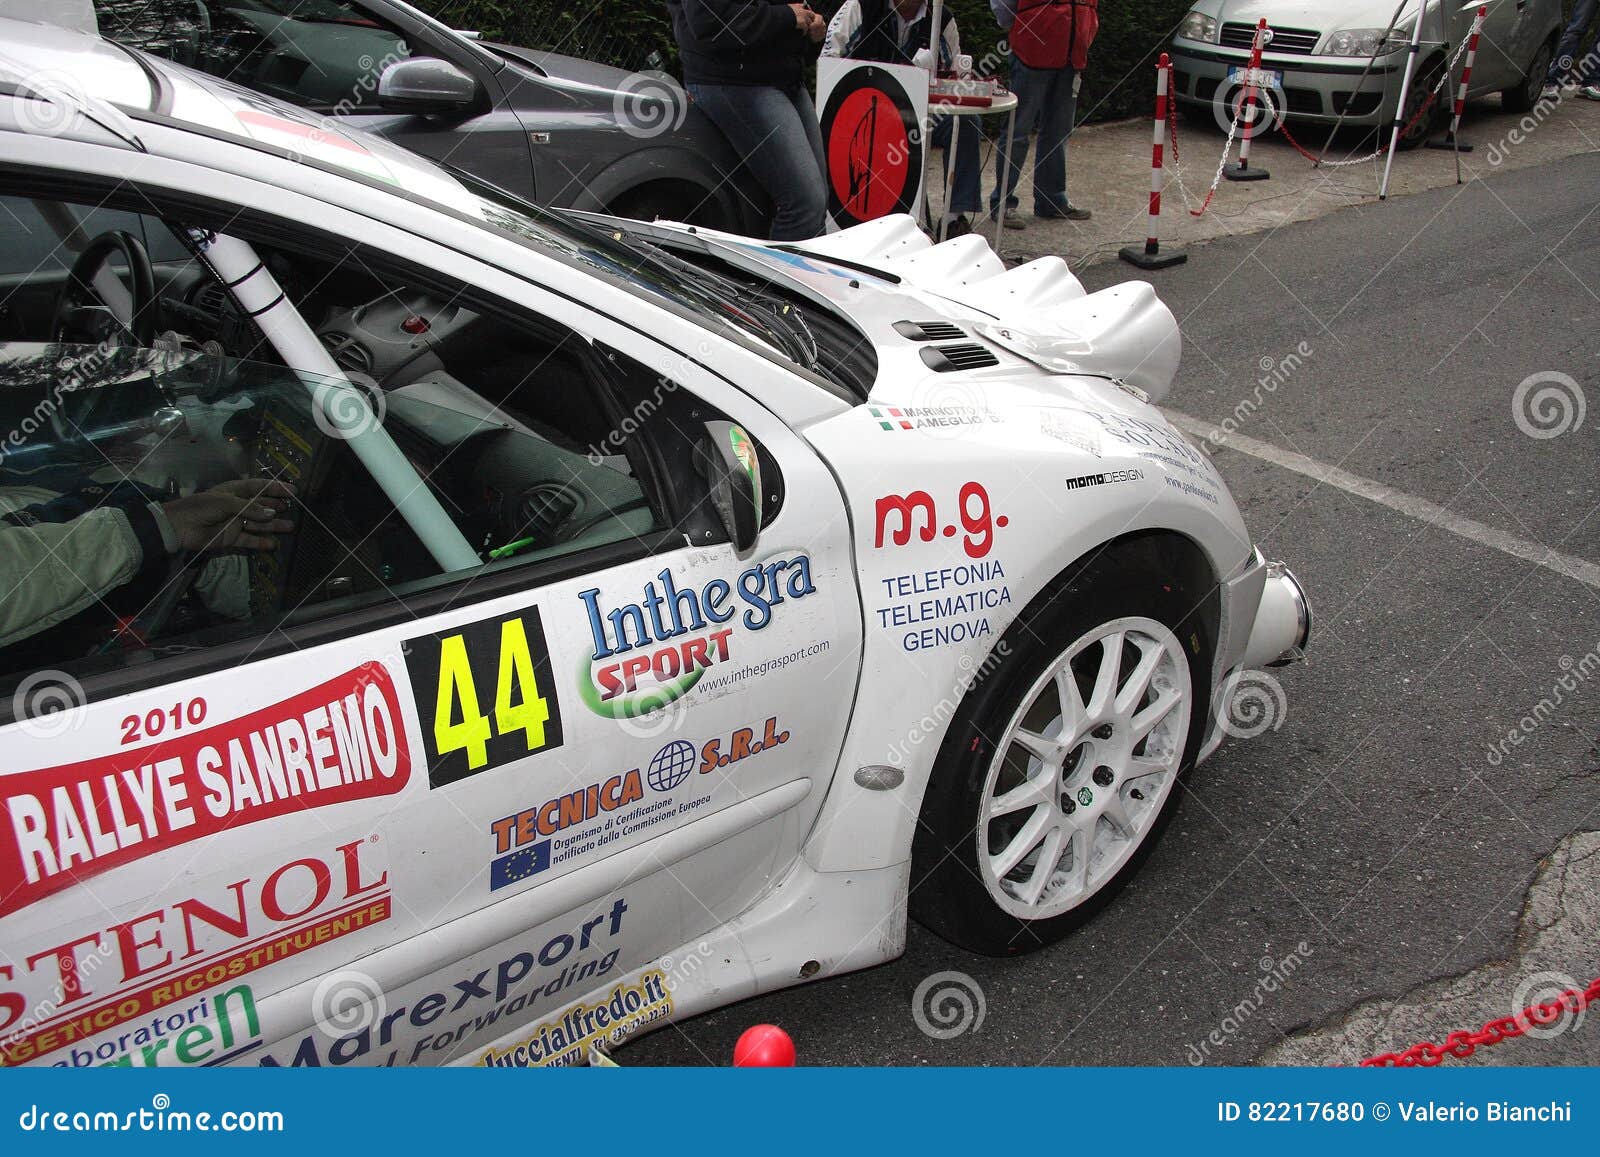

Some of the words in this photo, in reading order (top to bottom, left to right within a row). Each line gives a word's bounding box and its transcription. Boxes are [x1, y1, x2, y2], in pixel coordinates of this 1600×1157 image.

[875, 481, 1009, 558] m.g.
[877, 586, 1011, 628] TELEMATICA
[882, 560, 1004, 598] TELEFONIA
[597, 628, 732, 701] SPORT
[698, 640, 830, 693] www.inthegrasport.com
[903, 618, 990, 652] GENOVA
[121, 697, 207, 745] 2010
[434, 618, 549, 771] 44
[7, 757, 195, 884] RALLYE
[197, 682, 397, 818] SANREMO
[491, 768, 644, 854] TECNICA
[700, 716, 790, 774] S.R.L.
[553, 841, 595, 865] notificato
[597, 831, 620, 847] dalla
[622, 808, 677, 836] Commissione
[678, 795, 711, 814] Europea
[554, 826, 602, 850] Organismo
[605, 818, 614, 830] di
[616, 797, 673, 826] Certificazione
[151, 902, 386, 1006] RICOSTITUENTE
[409, 947, 621, 1065] Forwarding
[593, 1035, 609, 1049] Tel.
